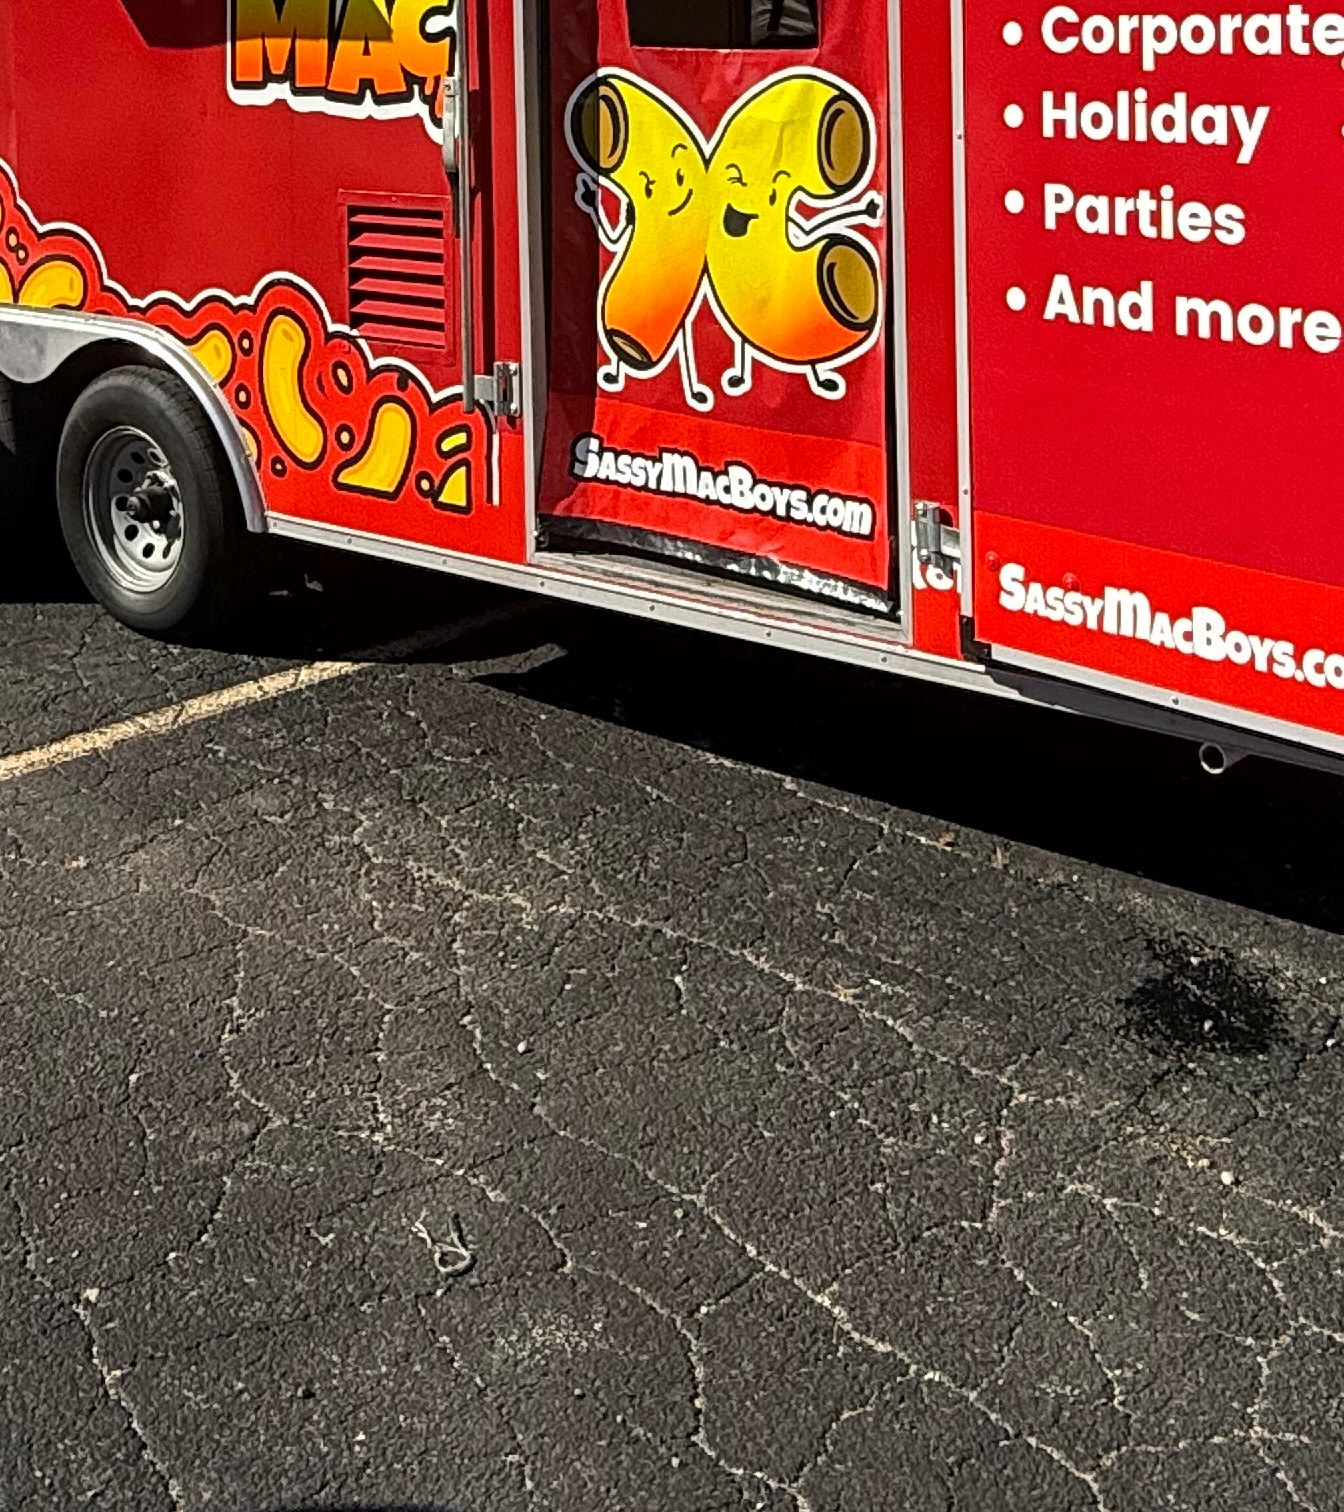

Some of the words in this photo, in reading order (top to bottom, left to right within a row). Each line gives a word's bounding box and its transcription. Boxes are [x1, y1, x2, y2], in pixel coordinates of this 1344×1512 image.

[1041, 87, 1271, 165] Holiday
[1043, 183, 1247, 246] Parties
[1042, 273, 1154, 332] And
